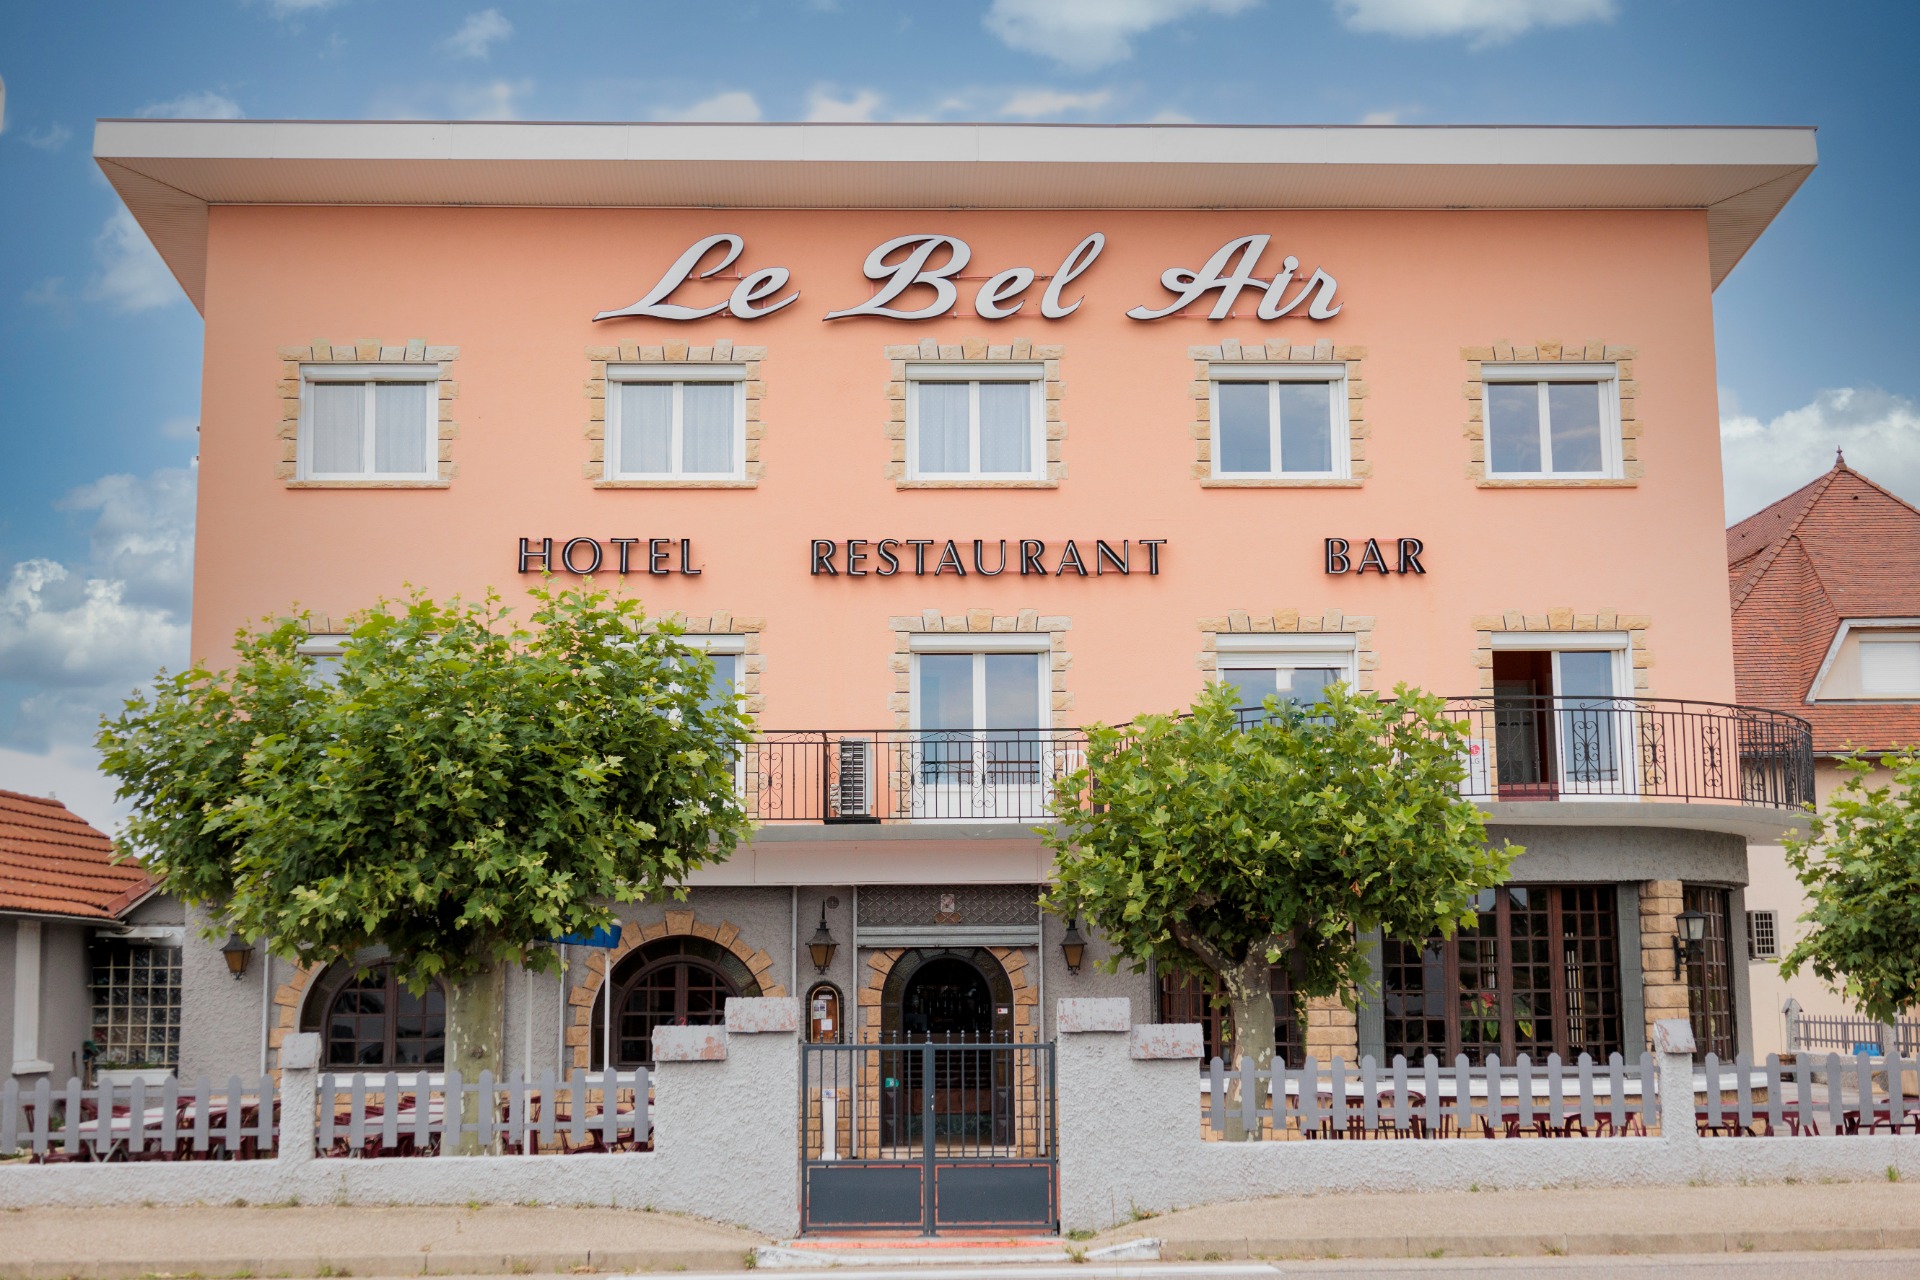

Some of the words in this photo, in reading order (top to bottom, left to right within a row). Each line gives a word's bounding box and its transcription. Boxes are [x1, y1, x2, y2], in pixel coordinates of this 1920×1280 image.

[592, 233, 800, 321] Le
[823, 232, 1105, 321] Bel
[1126, 234, 1344, 321] Air
[518, 537, 702, 575] HOTEL
[811, 539, 1168, 577] RESTAURANT
[1325, 538, 1427, 575] BAR
[1085, 1045, 1105, 1058] 25
